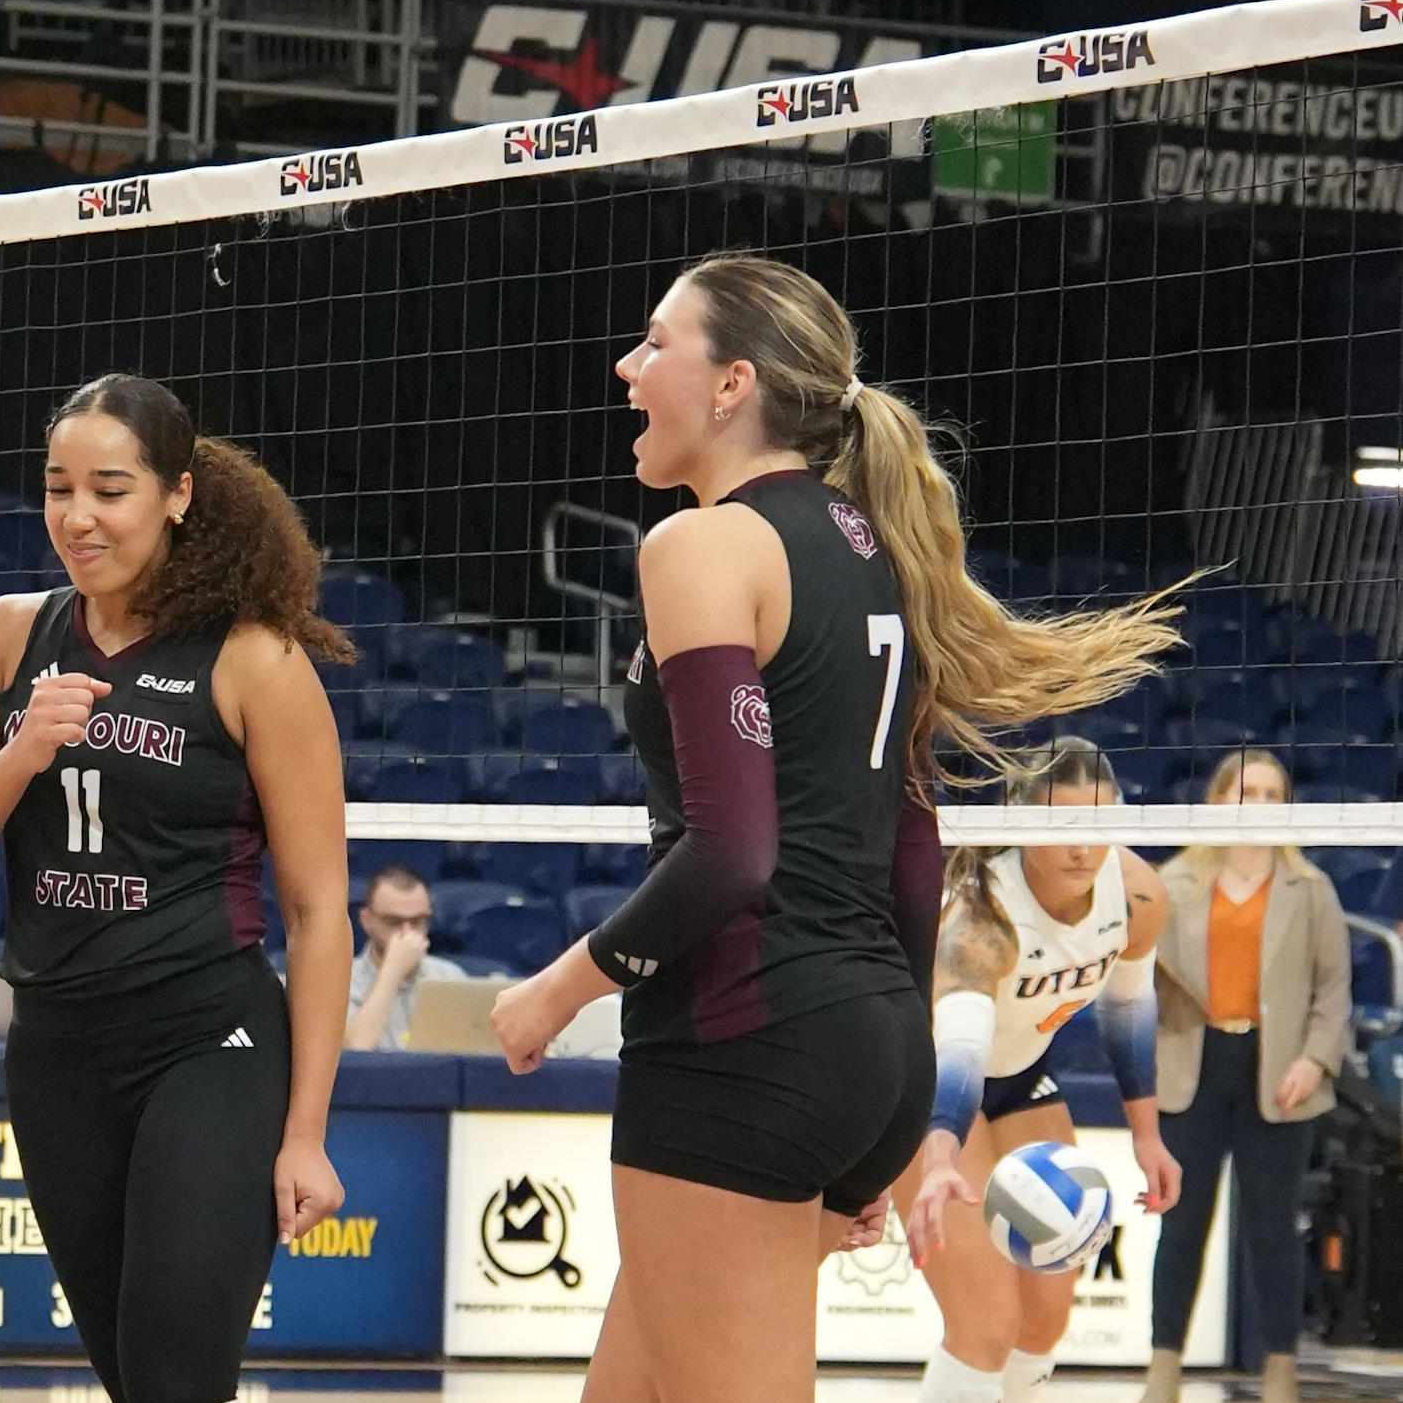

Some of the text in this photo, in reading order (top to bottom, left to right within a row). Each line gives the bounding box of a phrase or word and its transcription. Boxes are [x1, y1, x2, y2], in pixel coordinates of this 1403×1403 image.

[867, 614, 905, 770] 7
[4, 709, 186, 767] OURI
[60, 767, 104, 854] 11
[36, 870, 148, 911] STATE
